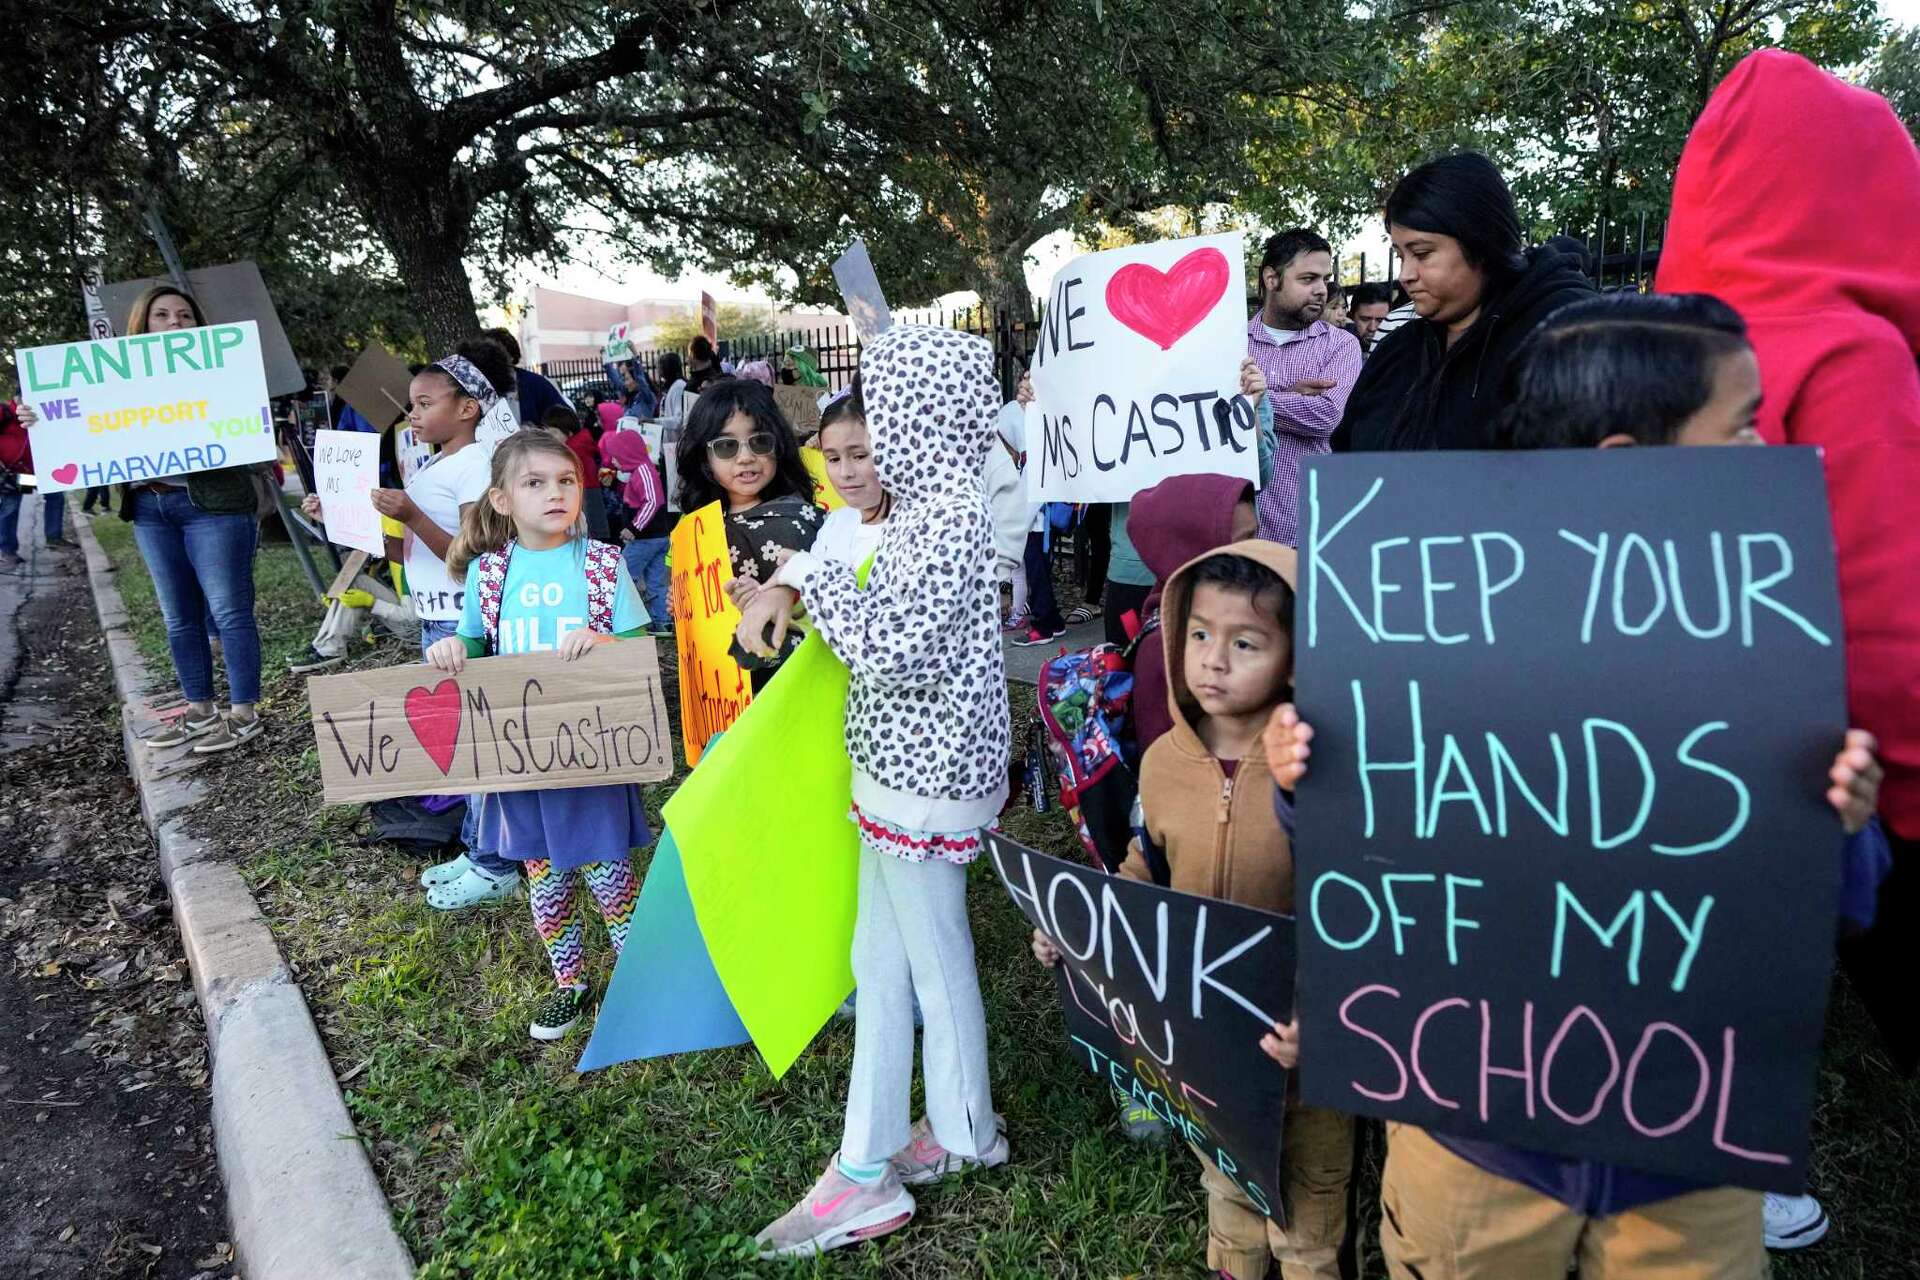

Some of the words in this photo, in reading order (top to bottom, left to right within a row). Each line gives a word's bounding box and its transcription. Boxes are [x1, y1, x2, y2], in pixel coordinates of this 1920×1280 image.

[25, 326, 244, 392] LANTRIP
[1039, 277, 1095, 368] WE
[40, 398, 81, 421] WE
[88, 400, 208, 434] SUPPORT
[209, 406, 271, 439] YOU!
[82, 444, 227, 486] HARVARD
[1040, 414, 1083, 489] MS.
[1092, 390, 1256, 472] CASTRO
[412, 589, 465, 613] stro
[520, 582, 564, 608] GO
[693, 516, 725, 619] for
[1309, 469, 1525, 648] KEEP
[1558, 528, 1832, 648] YOUR
[321, 699, 400, 777] We
[1351, 680, 1751, 856] HANDS
[990, 838, 1281, 1027] HONK
[1310, 870, 1483, 966] OFF
[1550, 881, 1714, 992] MY
[1128, 1108, 1160, 1121] FIL
[1339, 983, 1792, 1165] SCHOOL
[1070, 1034, 1271, 1216] TEACHERS
